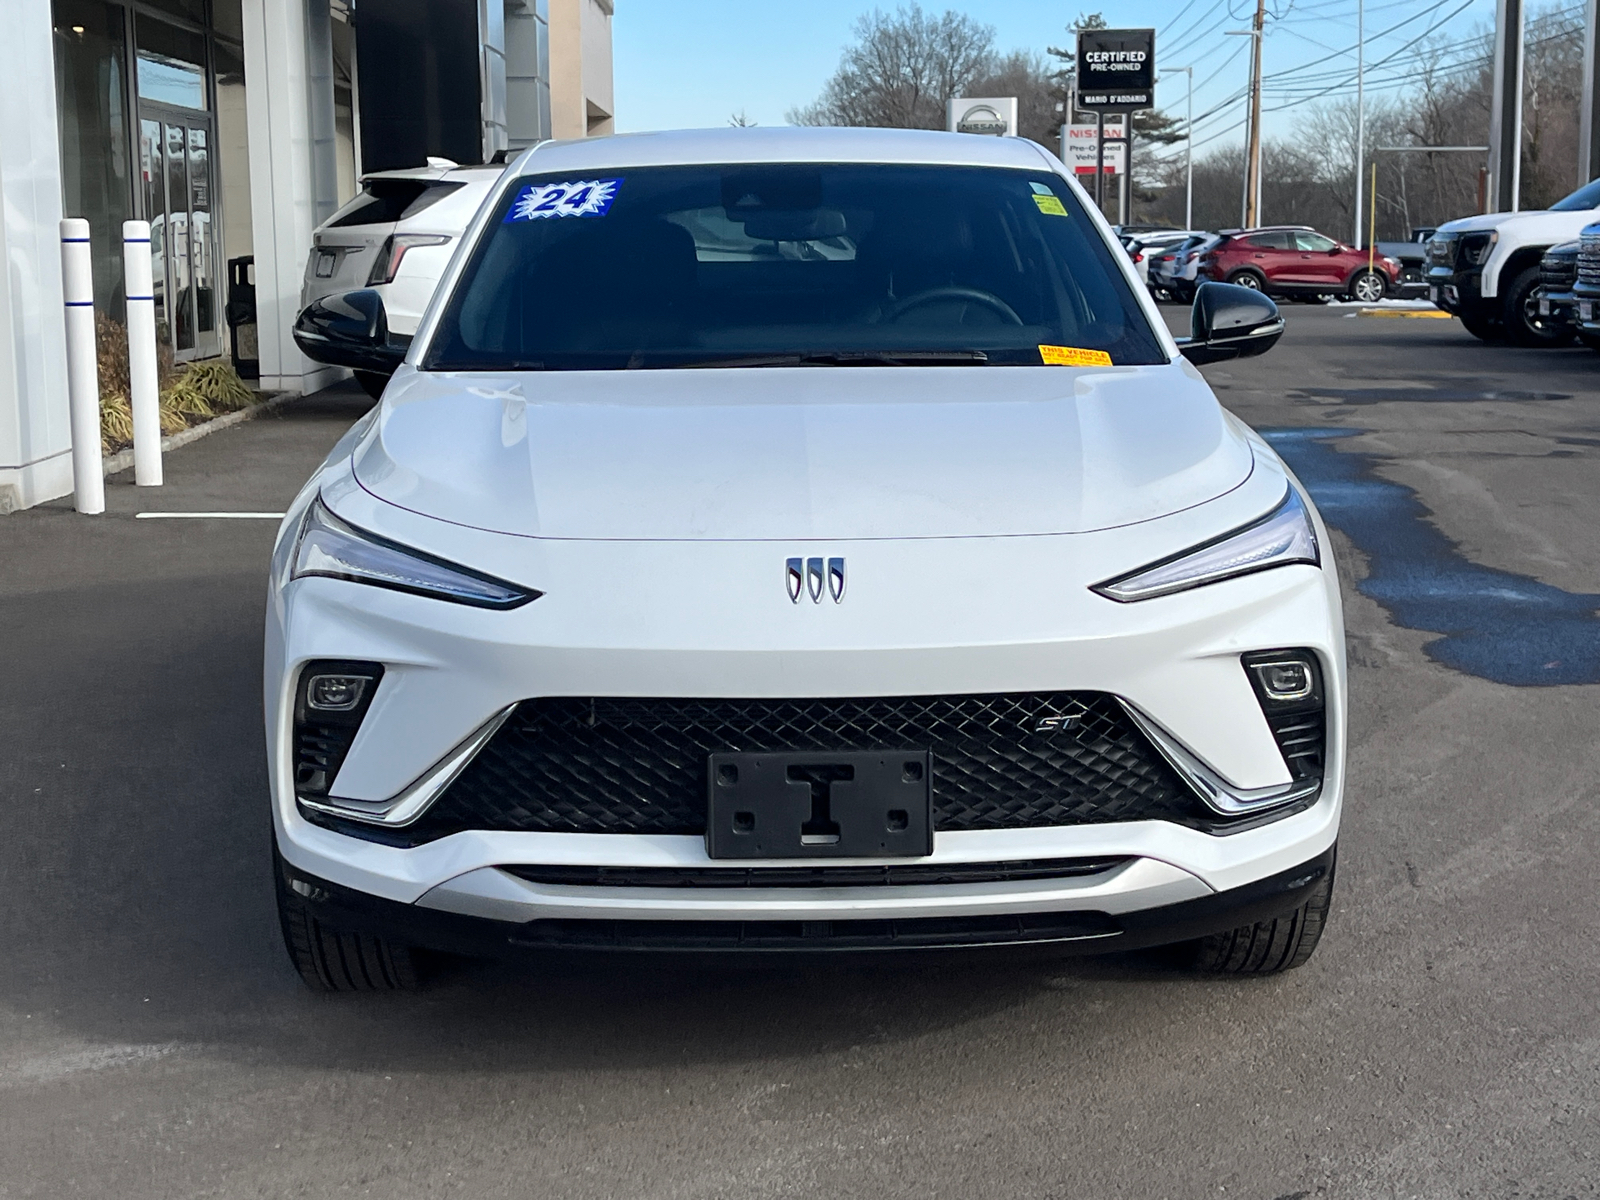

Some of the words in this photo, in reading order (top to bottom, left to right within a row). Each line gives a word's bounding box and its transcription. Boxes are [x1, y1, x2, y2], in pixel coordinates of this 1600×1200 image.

[1085, 51, 1146, 62] CERTIFIED
[1090, 63, 1141, 71] PRE-OWNED
[1085, 95, 1108, 104] MARIO
[1109, 94, 1147, 104] D'ADDARIO
[961, 123, 1004, 131] NISSAN
[532, 186, 593, 212] 24
[1066, 349, 1108, 358] VEHICLE
[1035, 714, 1082, 732] ST
